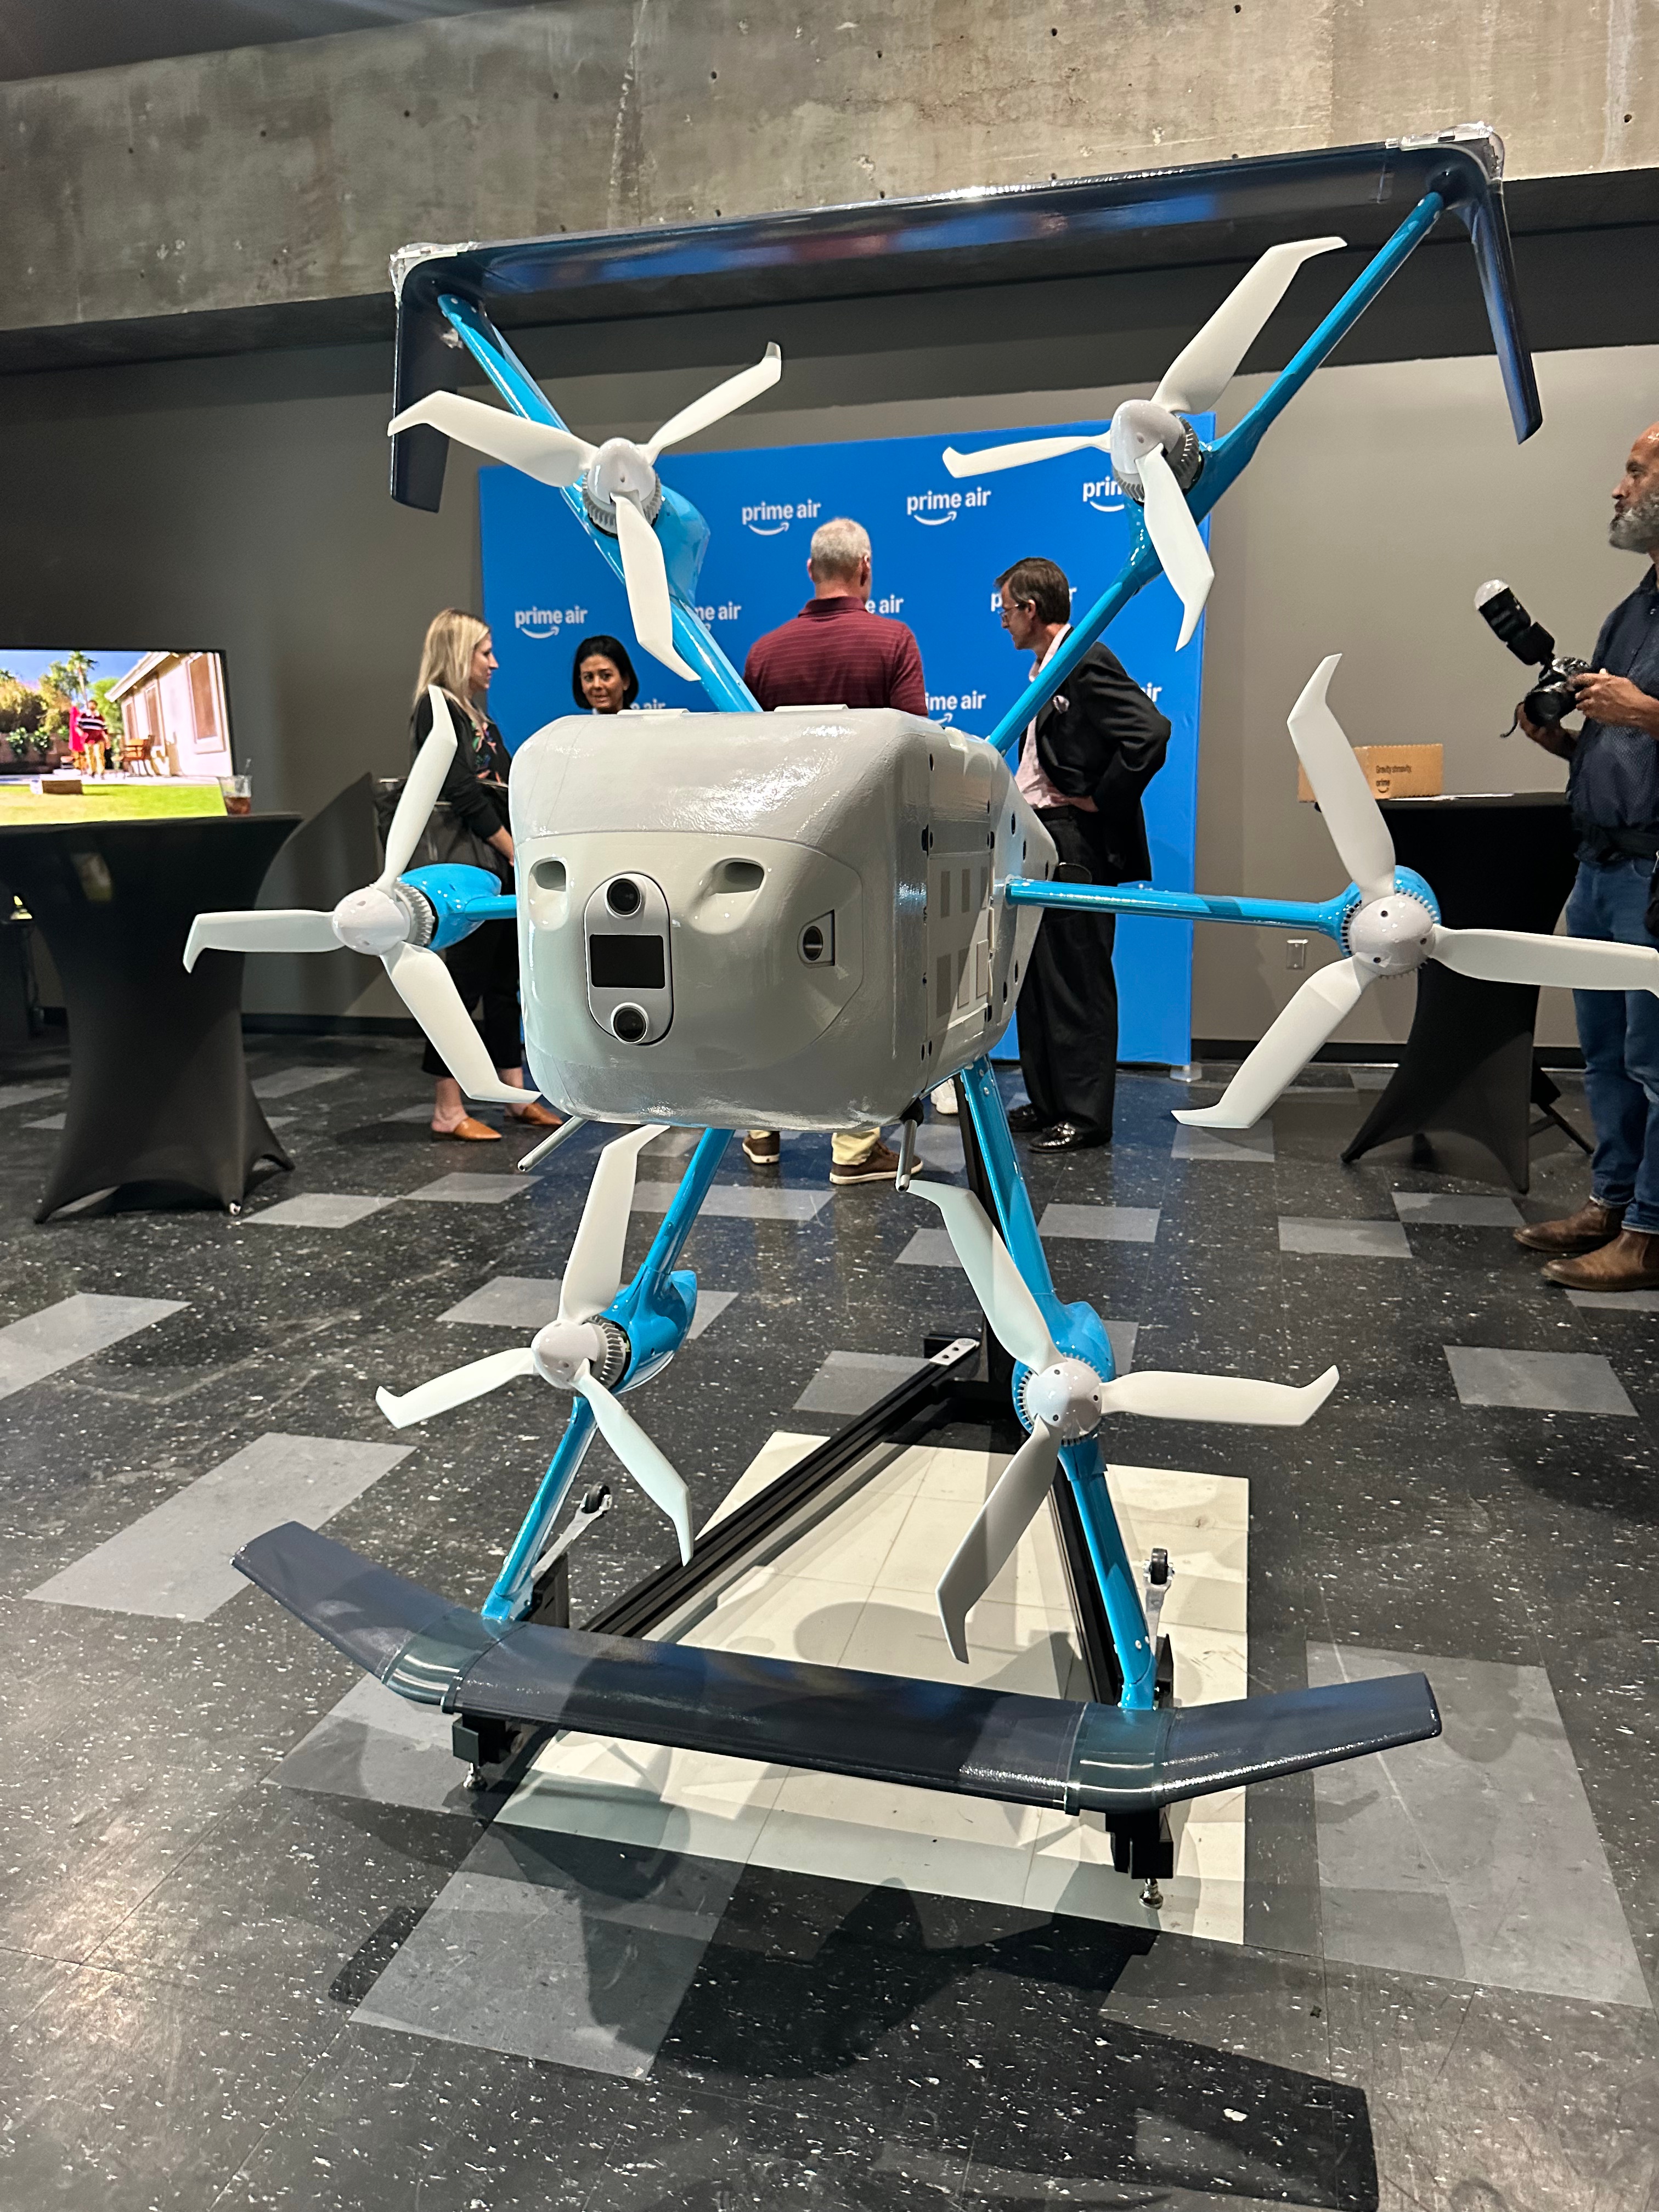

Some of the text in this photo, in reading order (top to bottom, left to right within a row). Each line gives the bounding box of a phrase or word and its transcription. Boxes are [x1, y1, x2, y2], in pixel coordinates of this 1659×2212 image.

[907, 486, 992, 515] prime air
[742, 498, 821, 524] prime air
[718, 600, 742, 620] air
[878, 594, 905, 614] air
[515, 605, 588, 628] prime air
[960, 690, 987, 710] air
[1141, 682, 1163, 702] ir
